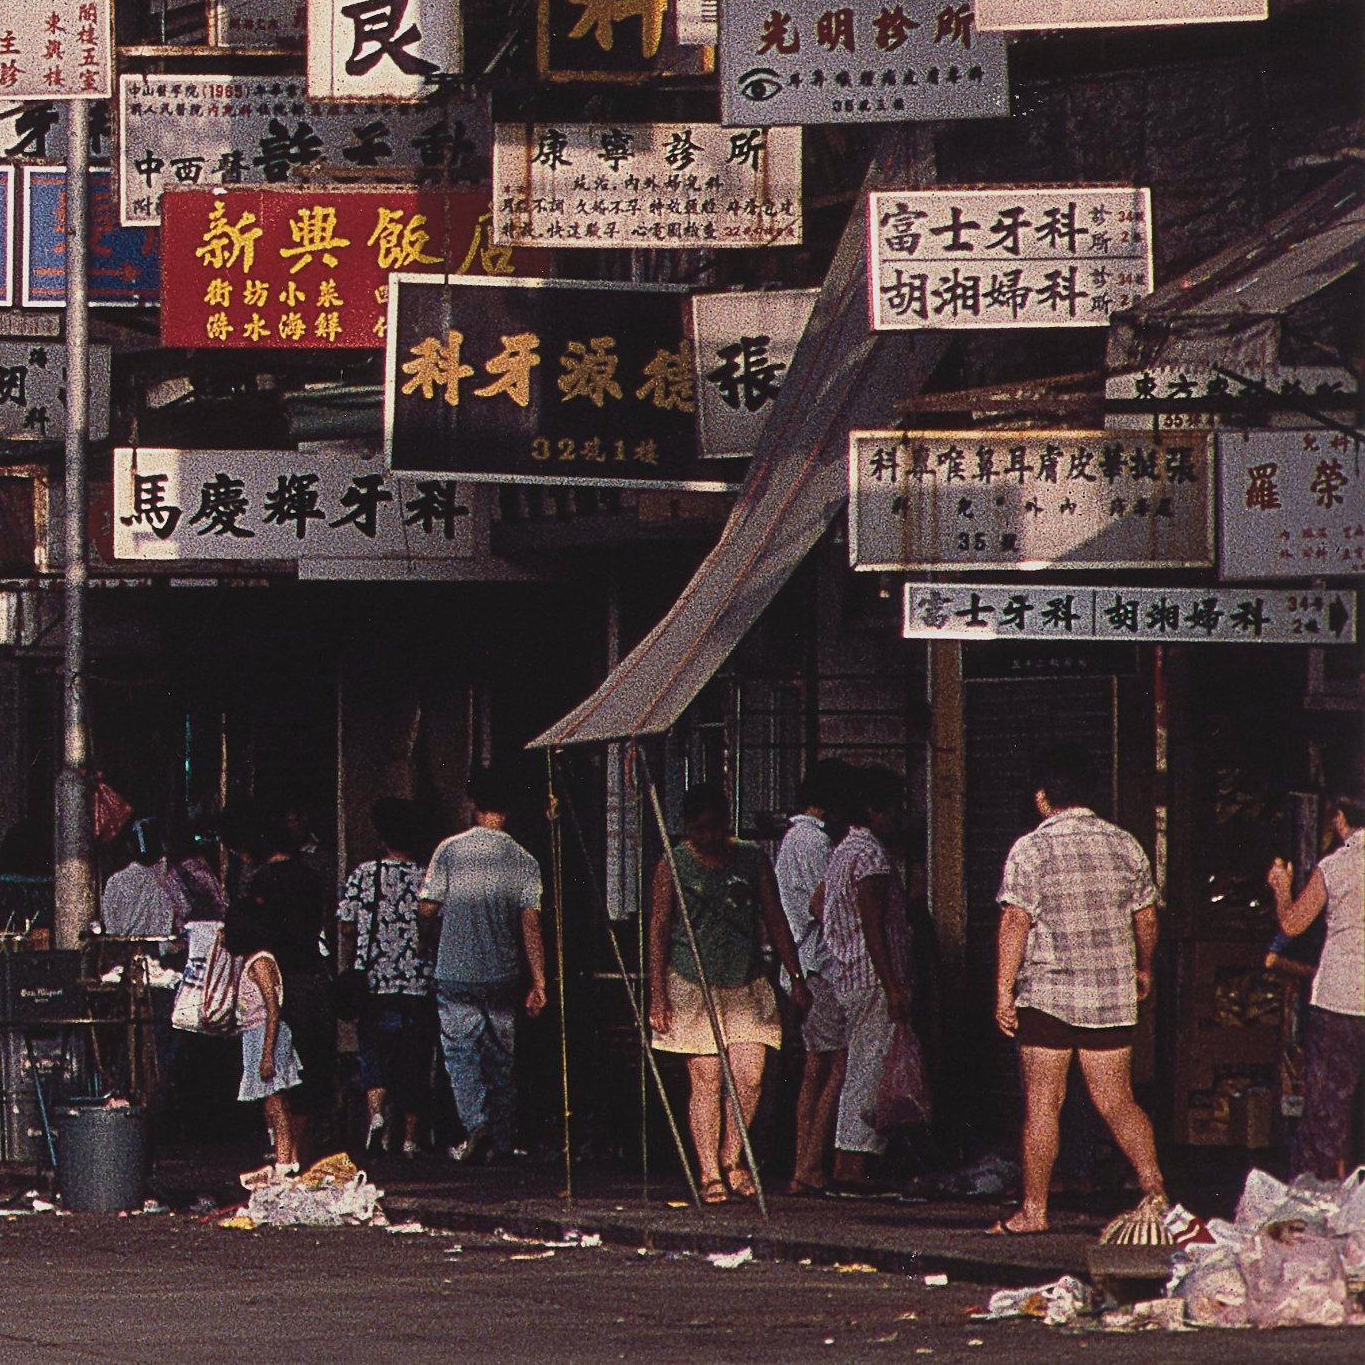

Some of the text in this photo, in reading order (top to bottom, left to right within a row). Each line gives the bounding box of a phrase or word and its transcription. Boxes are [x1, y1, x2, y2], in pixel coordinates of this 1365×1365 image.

[195, 199, 518, 276] 新興飯店
[880, 201, 1089, 256] 富士牙科
[880, 265, 1089, 320] 胡湘婦科
[119, 472, 471, 541] 馬慶輝牙科
